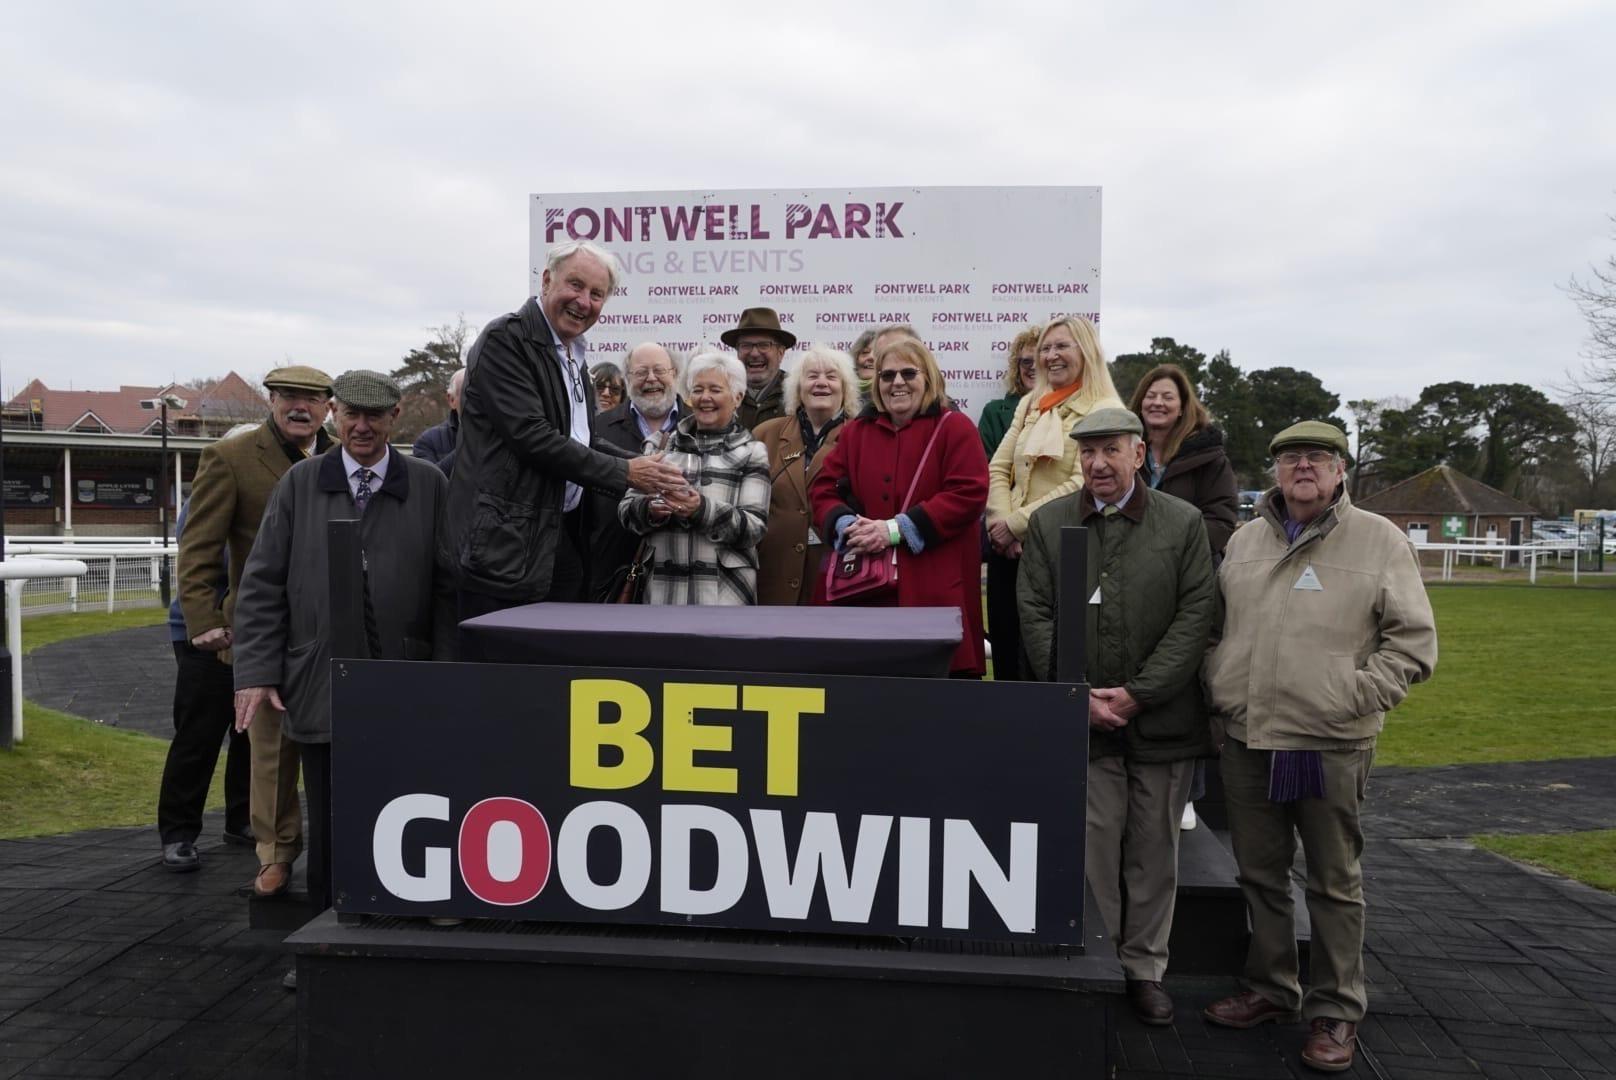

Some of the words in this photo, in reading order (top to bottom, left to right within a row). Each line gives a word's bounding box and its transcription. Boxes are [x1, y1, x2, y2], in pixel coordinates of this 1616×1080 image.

[545, 203, 770, 243] FONTWELL
[785, 201, 905, 239] PARK
[663, 250, 684, 274] &
[692, 249, 804, 273] EVENTS
[613, 286, 628, 297] RK
[647, 285, 706, 296] FONTWELL
[709, 285, 739, 296] PARK
[759, 284, 819, 295] FONTWELL
[822, 284, 853, 295] PARK
[874, 283, 936, 294] FONTWELL
[939, 283, 970, 294] PARK
[992, 283, 1054, 294] FONTWELL
[1057, 283, 1089, 294] PARK
[598, 314, 649, 324] ONTWELL
[652, 313, 682, 324] PARK
[702, 313, 741, 323] FONTW
[779, 313, 795, 323] RK
[815, 312, 876, 323] FONTWELL
[879, 312, 910, 323] PARK
[932, 312, 993, 323] FONTWELL
[996, 312, 1028, 323] PARK
[598, 342, 627, 352] PARK
[938, 342, 969, 351] PARK
[940, 370, 992, 380] ONTWELL
[569, 679, 826, 796] BET
[373, 793, 1039, 933] GOODWIN
